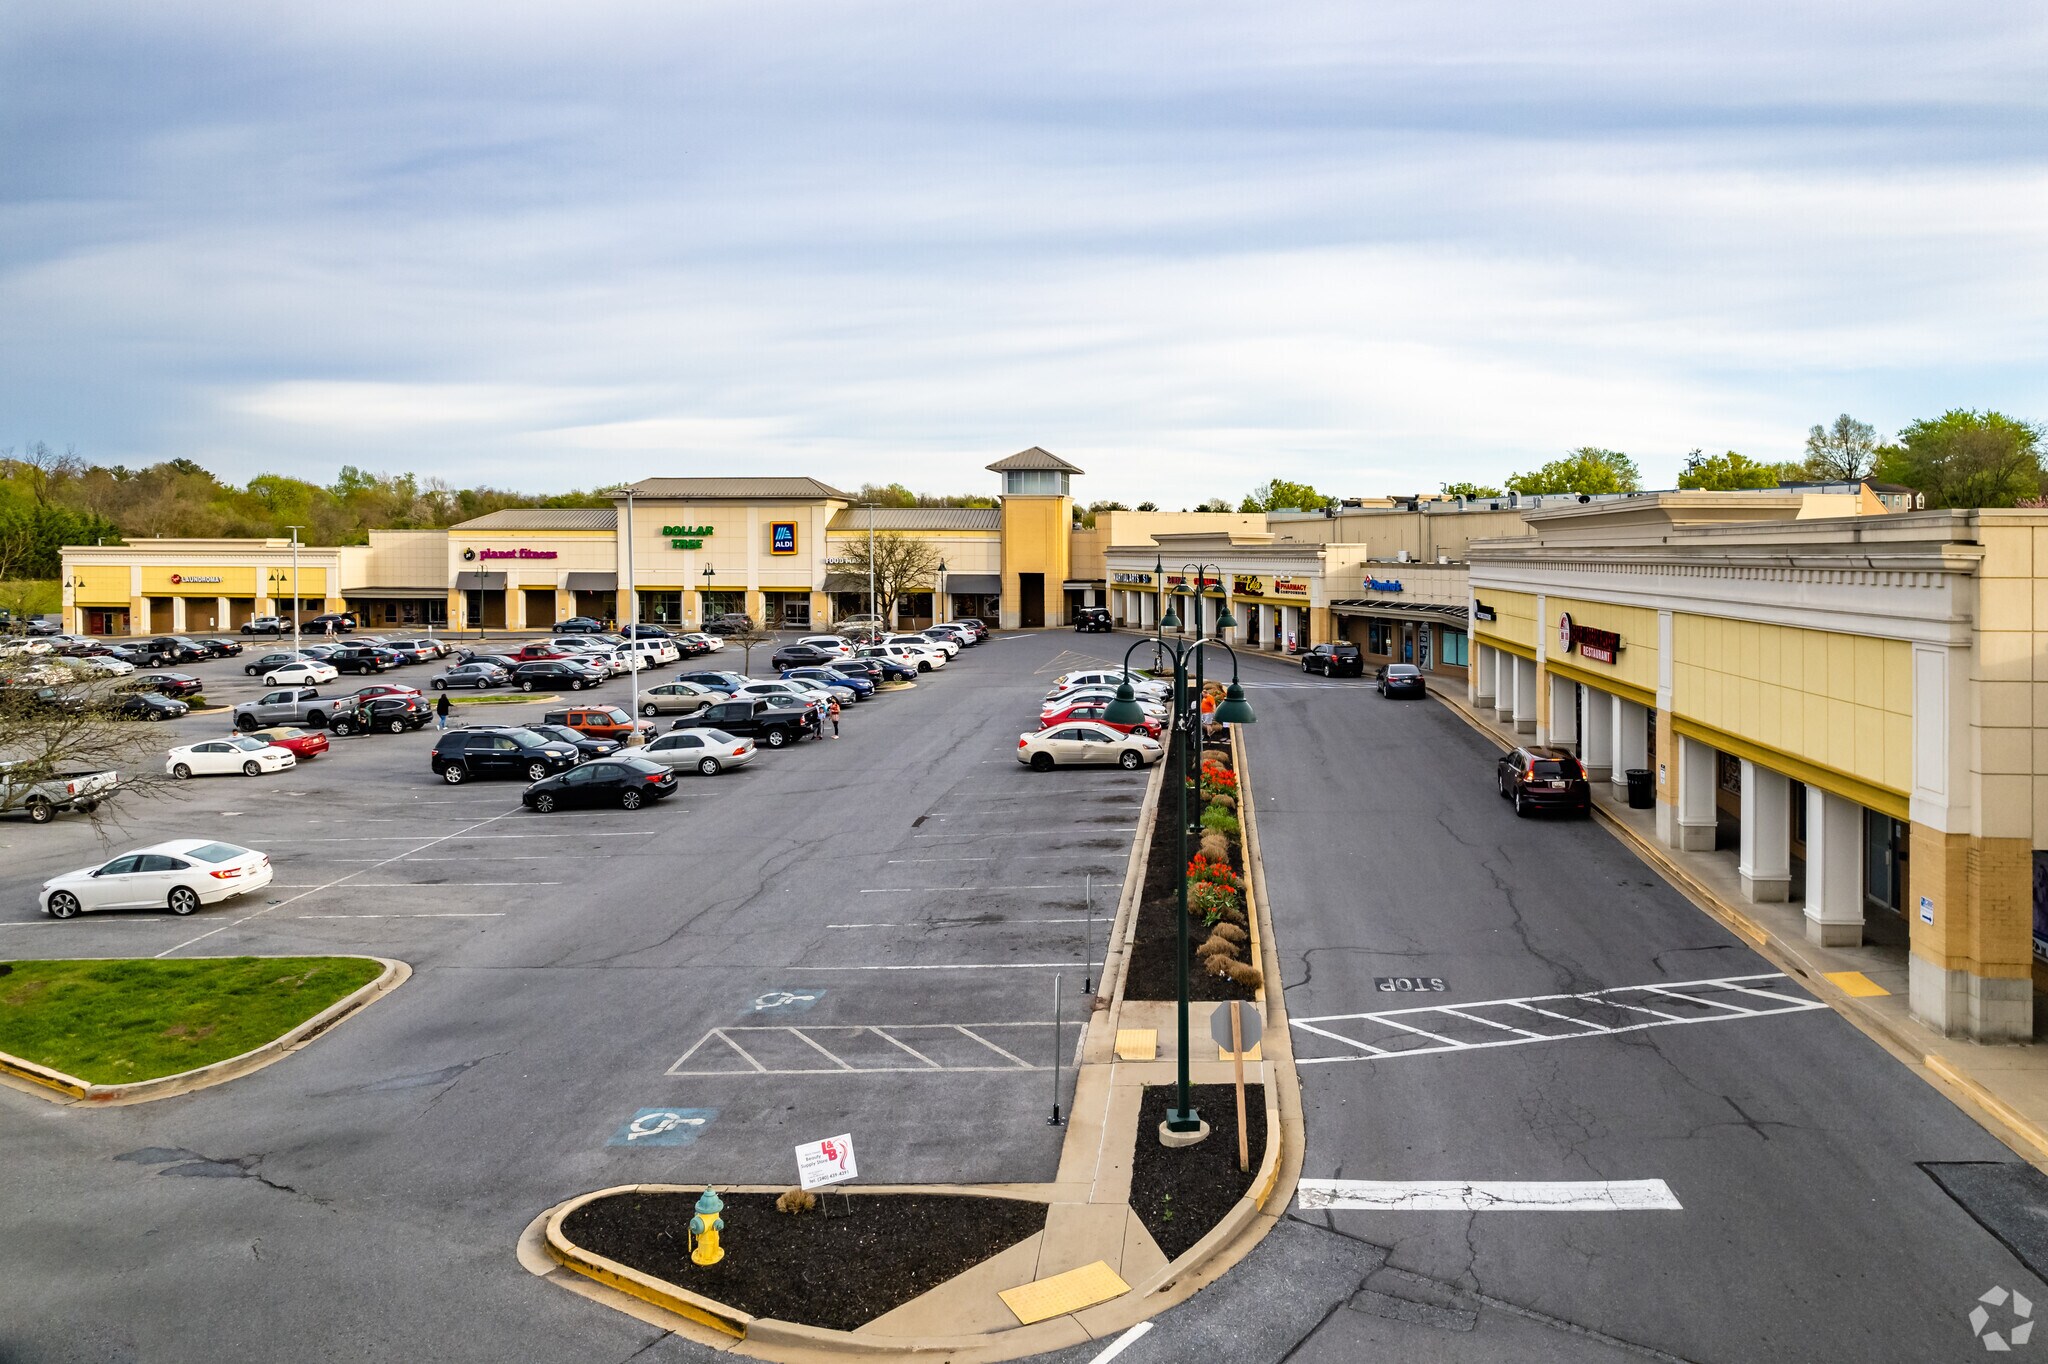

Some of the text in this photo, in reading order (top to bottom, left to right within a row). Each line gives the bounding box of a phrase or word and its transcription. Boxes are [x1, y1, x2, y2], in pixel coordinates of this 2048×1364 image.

[662, 525, 714, 536] DOLLAR
[671, 539, 703, 549] TREE
[480, 548, 558, 561] planet fitness
[1280, 583, 1307, 591] PHARMACY
[1583, 646, 1610, 662] RESTAURANT
[1379, 977, 1446, 992] STOP
